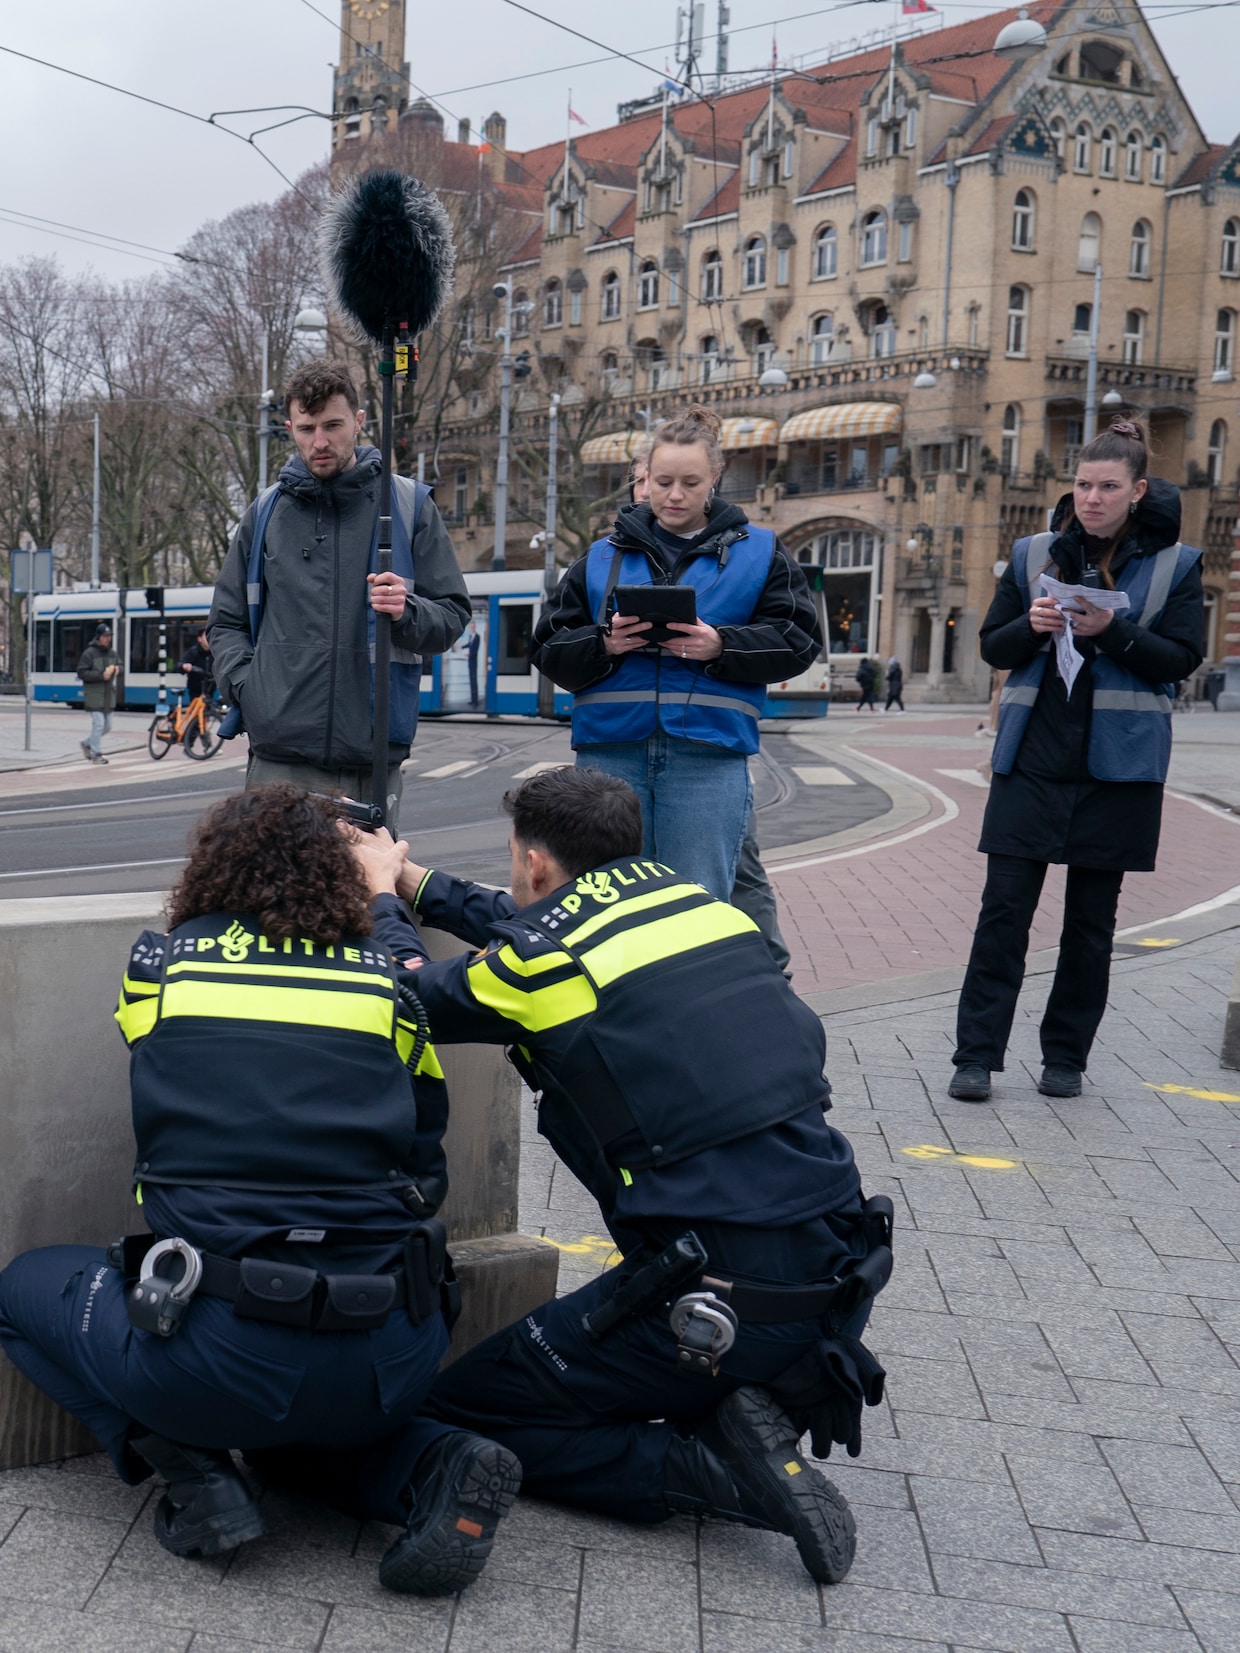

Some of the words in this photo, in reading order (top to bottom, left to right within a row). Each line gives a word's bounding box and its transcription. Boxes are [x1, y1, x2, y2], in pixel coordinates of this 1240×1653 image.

[559, 861, 677, 915] POLITI
[196, 930, 362, 963] POLITIE
[83, 1274, 103, 1320] POLITIE
[529, 1324, 560, 1362] POLITIE
